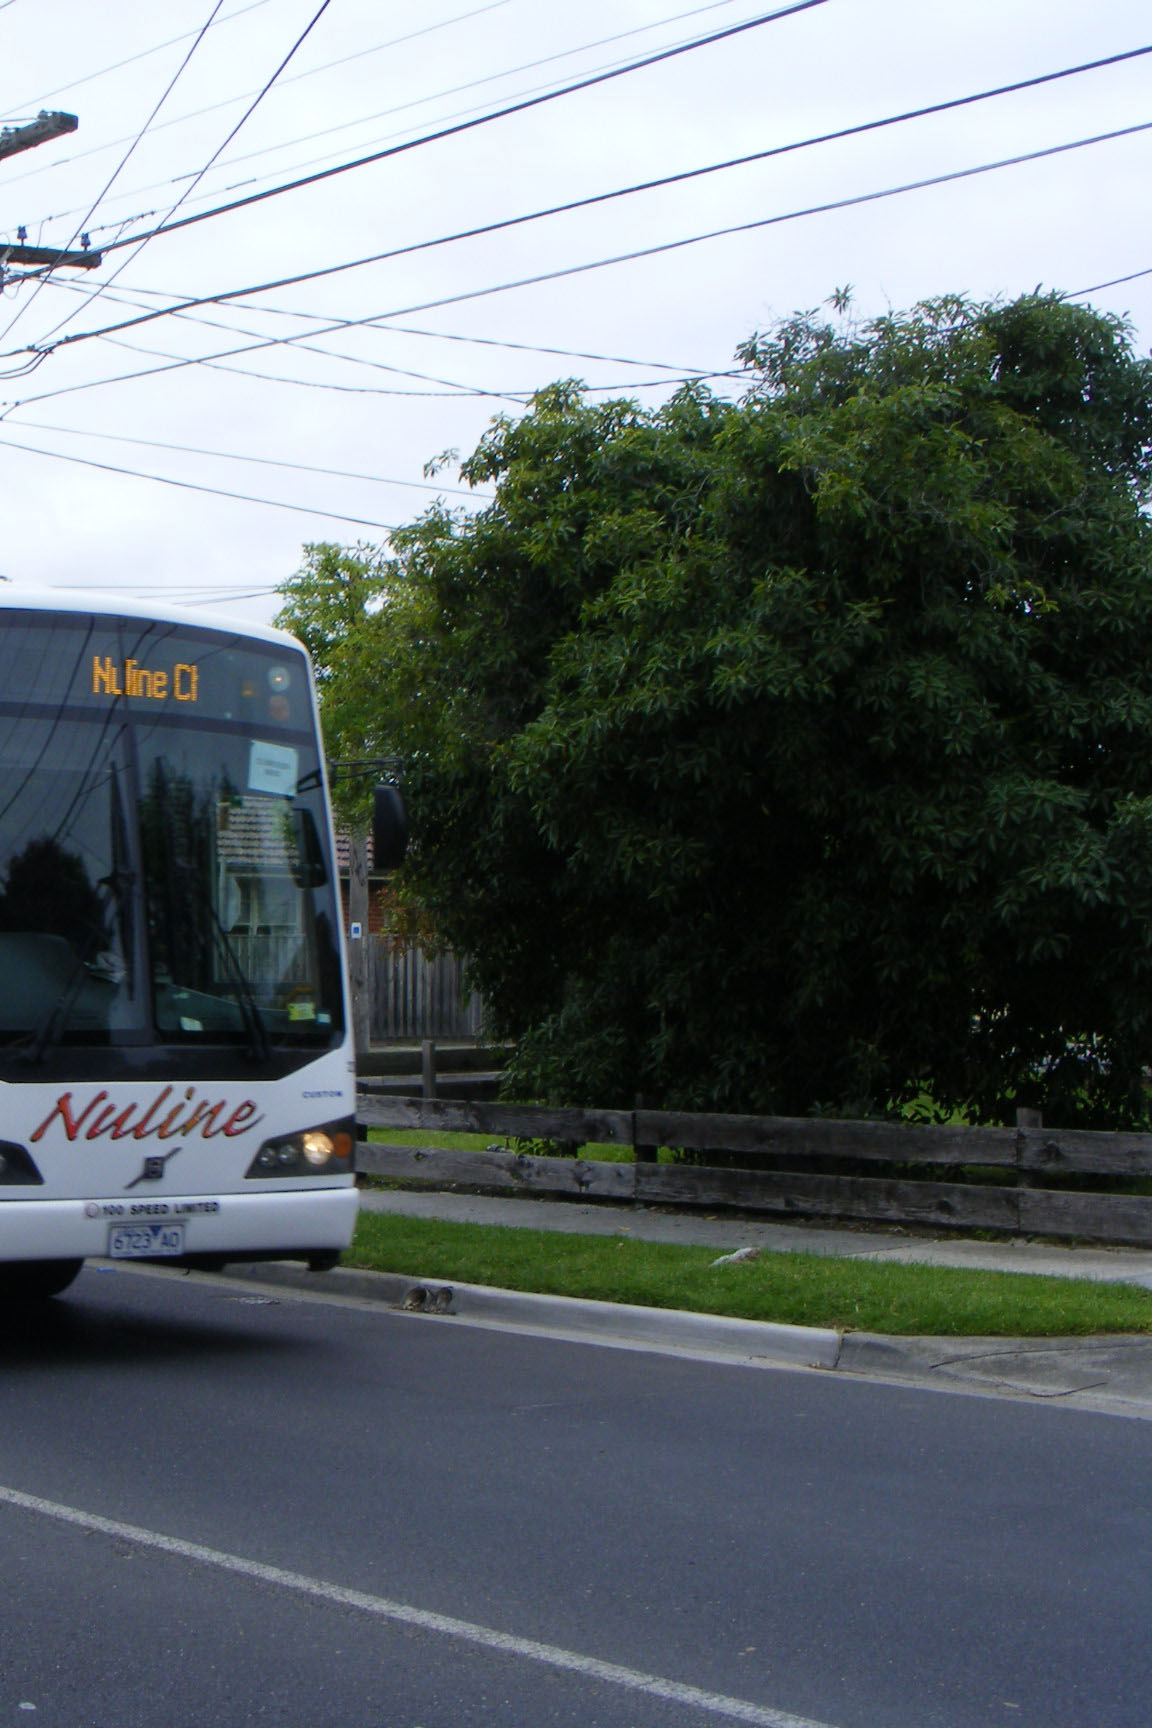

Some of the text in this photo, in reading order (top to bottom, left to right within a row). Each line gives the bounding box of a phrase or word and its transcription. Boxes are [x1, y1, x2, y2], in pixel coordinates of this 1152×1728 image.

[30, 1084, 265, 1143] Nuline
[102, 1201, 219, 1216] 100 SPEED LIMITED
